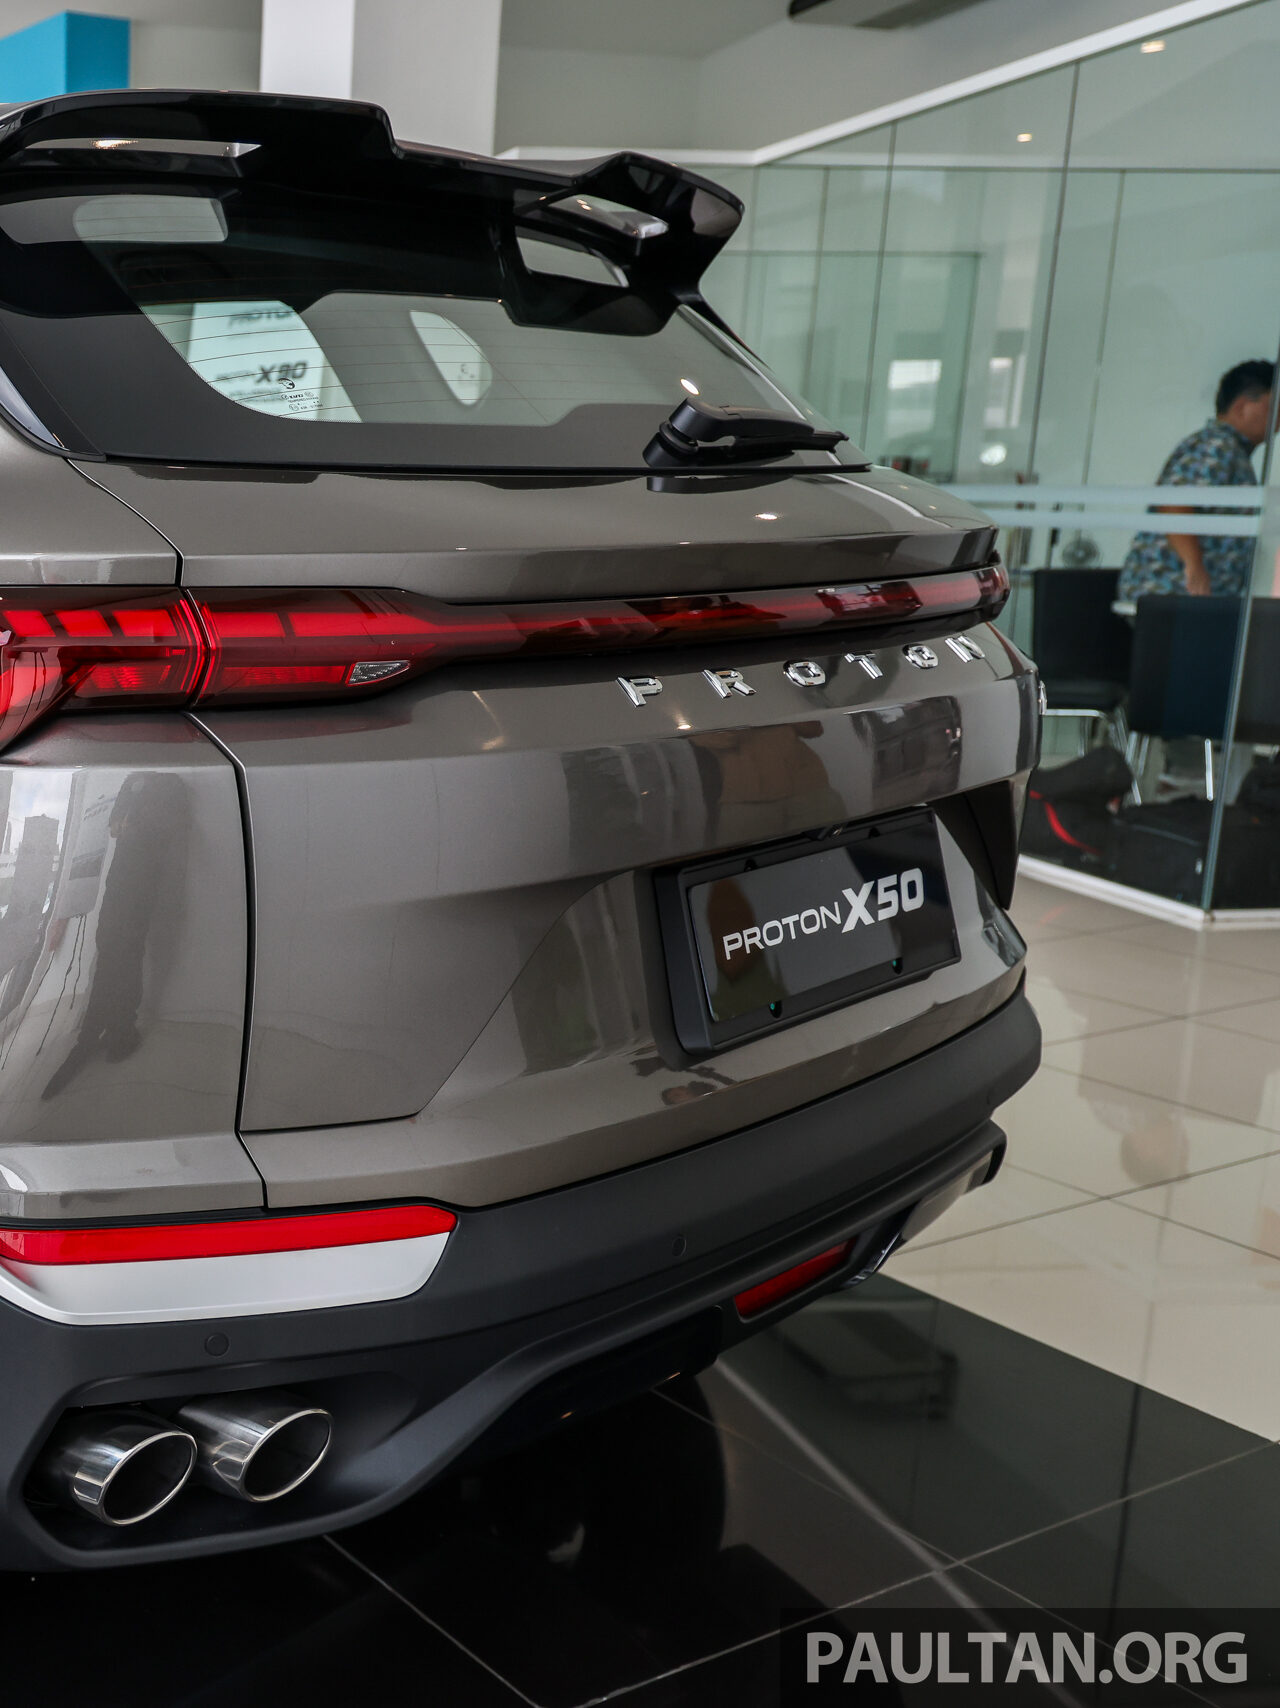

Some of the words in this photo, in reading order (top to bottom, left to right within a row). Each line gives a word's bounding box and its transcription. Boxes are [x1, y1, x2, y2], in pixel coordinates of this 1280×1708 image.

[616, 635, 985, 708] PROTON
[722, 902, 842, 960] PROTON
[841, 868, 925, 933] X50
